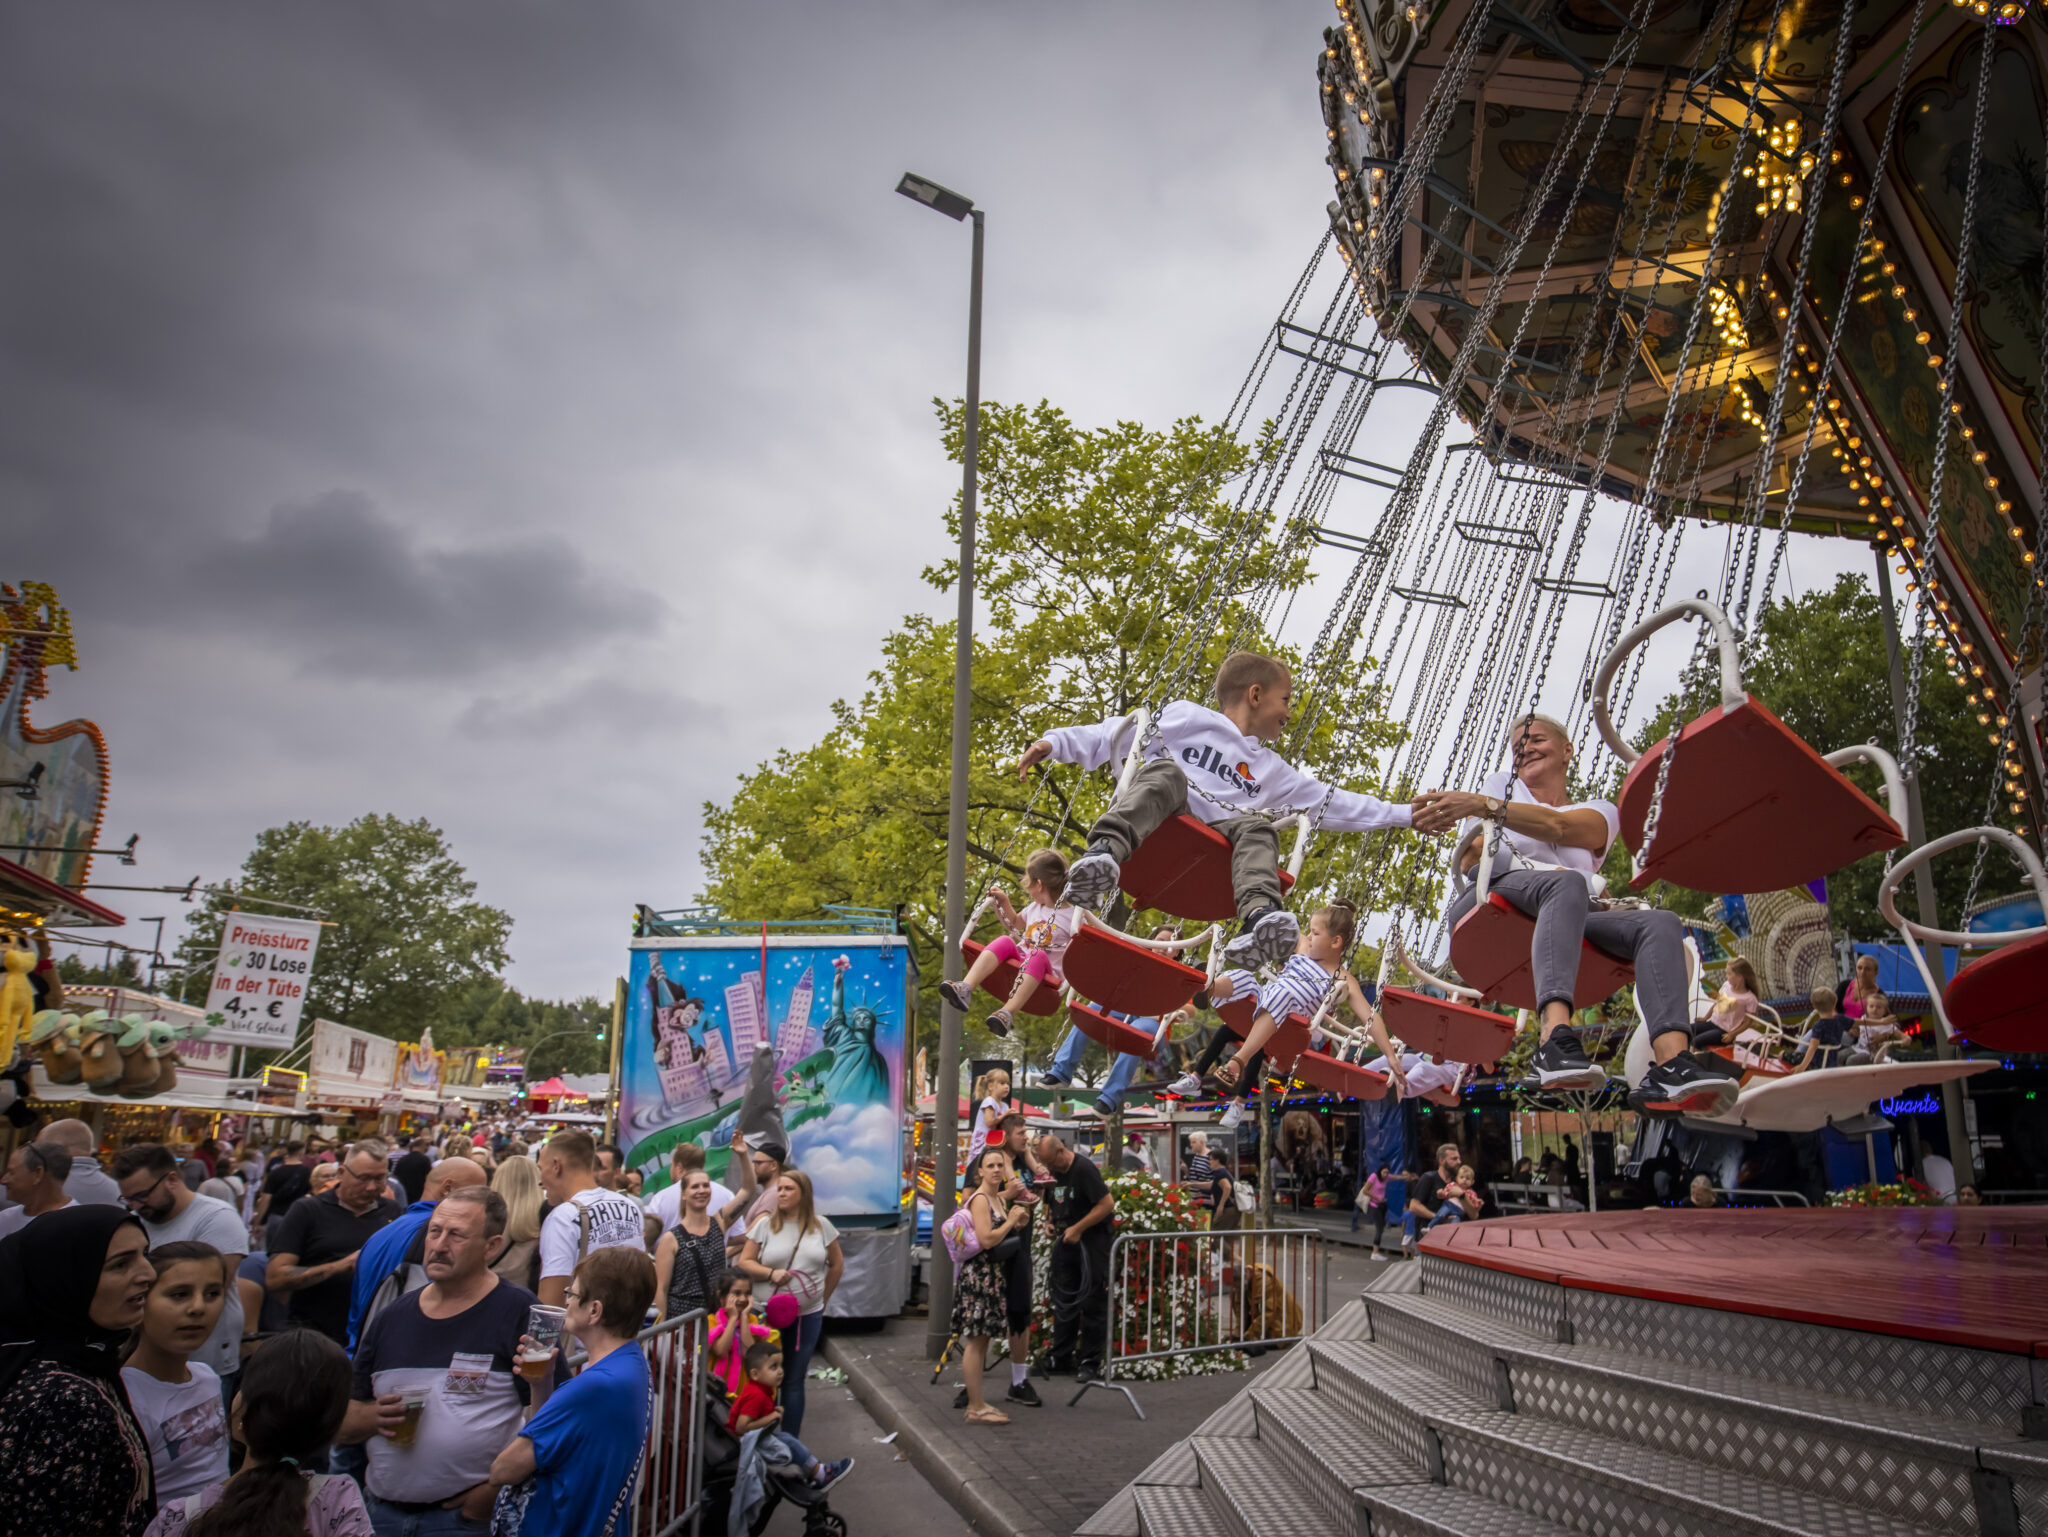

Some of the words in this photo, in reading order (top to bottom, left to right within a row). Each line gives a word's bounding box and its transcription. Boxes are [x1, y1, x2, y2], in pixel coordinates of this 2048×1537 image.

[1182, 745, 1262, 798] ellesse
[231, 926, 310, 951] Preissturz
[246, 951, 267, 970] 30
[270, 954, 307, 974] Lose
[215, 973, 232, 991] in
[235, 975, 263, 994] der
[267, 978, 302, 998] Tüte
[267, 1001, 284, 1018] €
[231, 1020, 253, 1030] Viel
[1880, 1092, 1940, 1117] Quante
